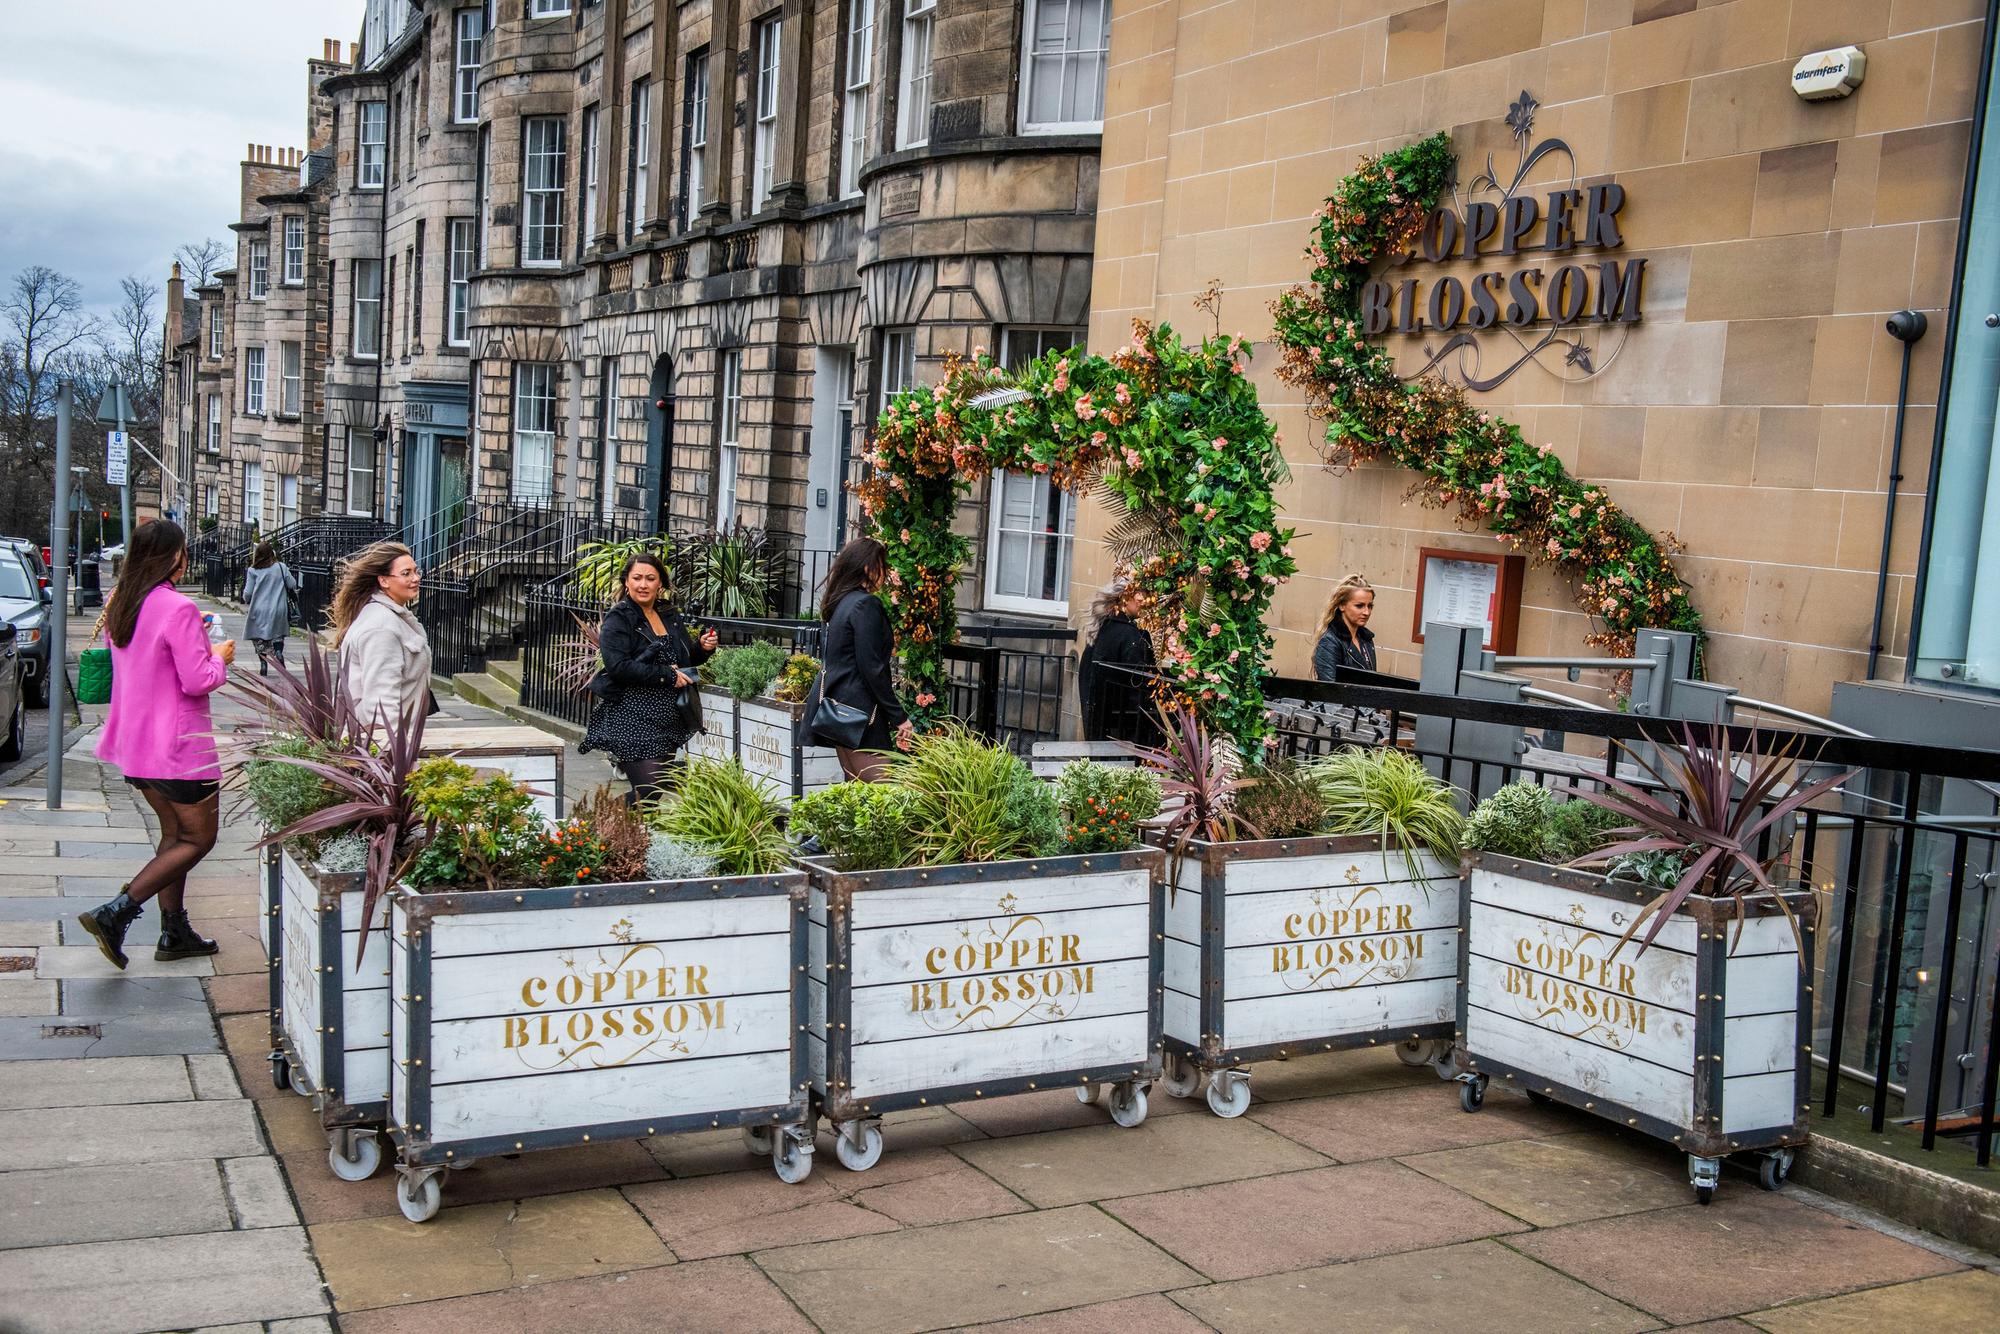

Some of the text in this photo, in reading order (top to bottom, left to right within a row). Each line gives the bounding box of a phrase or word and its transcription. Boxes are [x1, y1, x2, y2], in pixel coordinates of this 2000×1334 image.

[1386, 183, 1626, 266] OPPER
[1360, 258, 1649, 336] BLOSSOM
[751, 732, 780, 752] COPPER
[1284, 904, 1414, 939] COPPER
[925, 934, 1082, 975] COPPER
[1271, 933, 1425, 973] BLOSSOM
[1516, 937, 1636, 996] COPPER
[521, 964, 711, 1008] COPPER
[911, 966, 1095, 1012] BLOSSOM
[1505, 965, 1648, 1034] BLOSSOM
[503, 1000, 728, 1048] BLOSSOM
